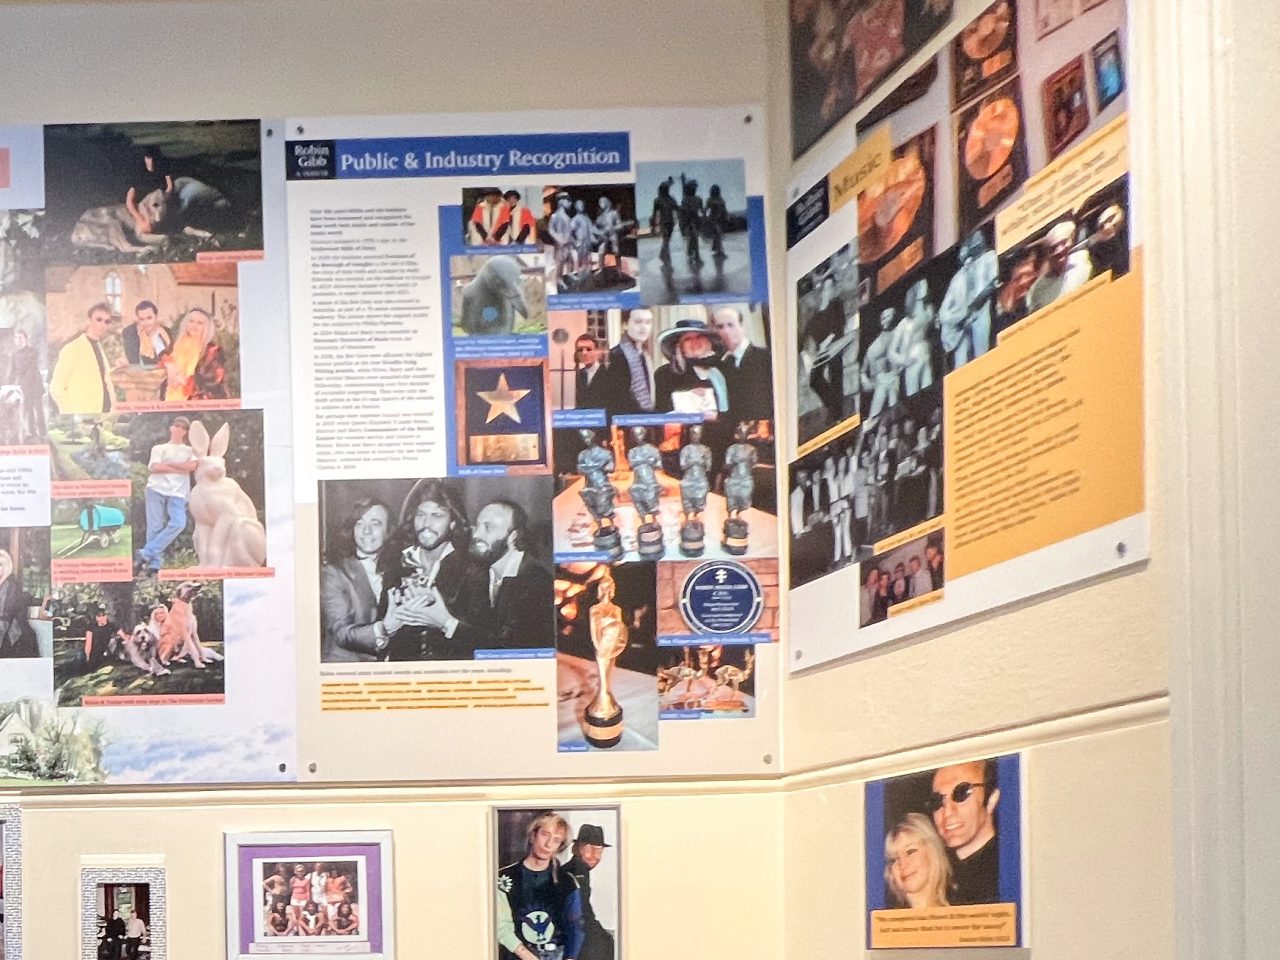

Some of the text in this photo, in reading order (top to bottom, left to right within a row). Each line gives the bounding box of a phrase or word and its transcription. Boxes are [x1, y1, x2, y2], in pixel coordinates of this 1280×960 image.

[341, 147, 620, 172] Public & Industry Recognition
[834, 153, 882, 201] Music
